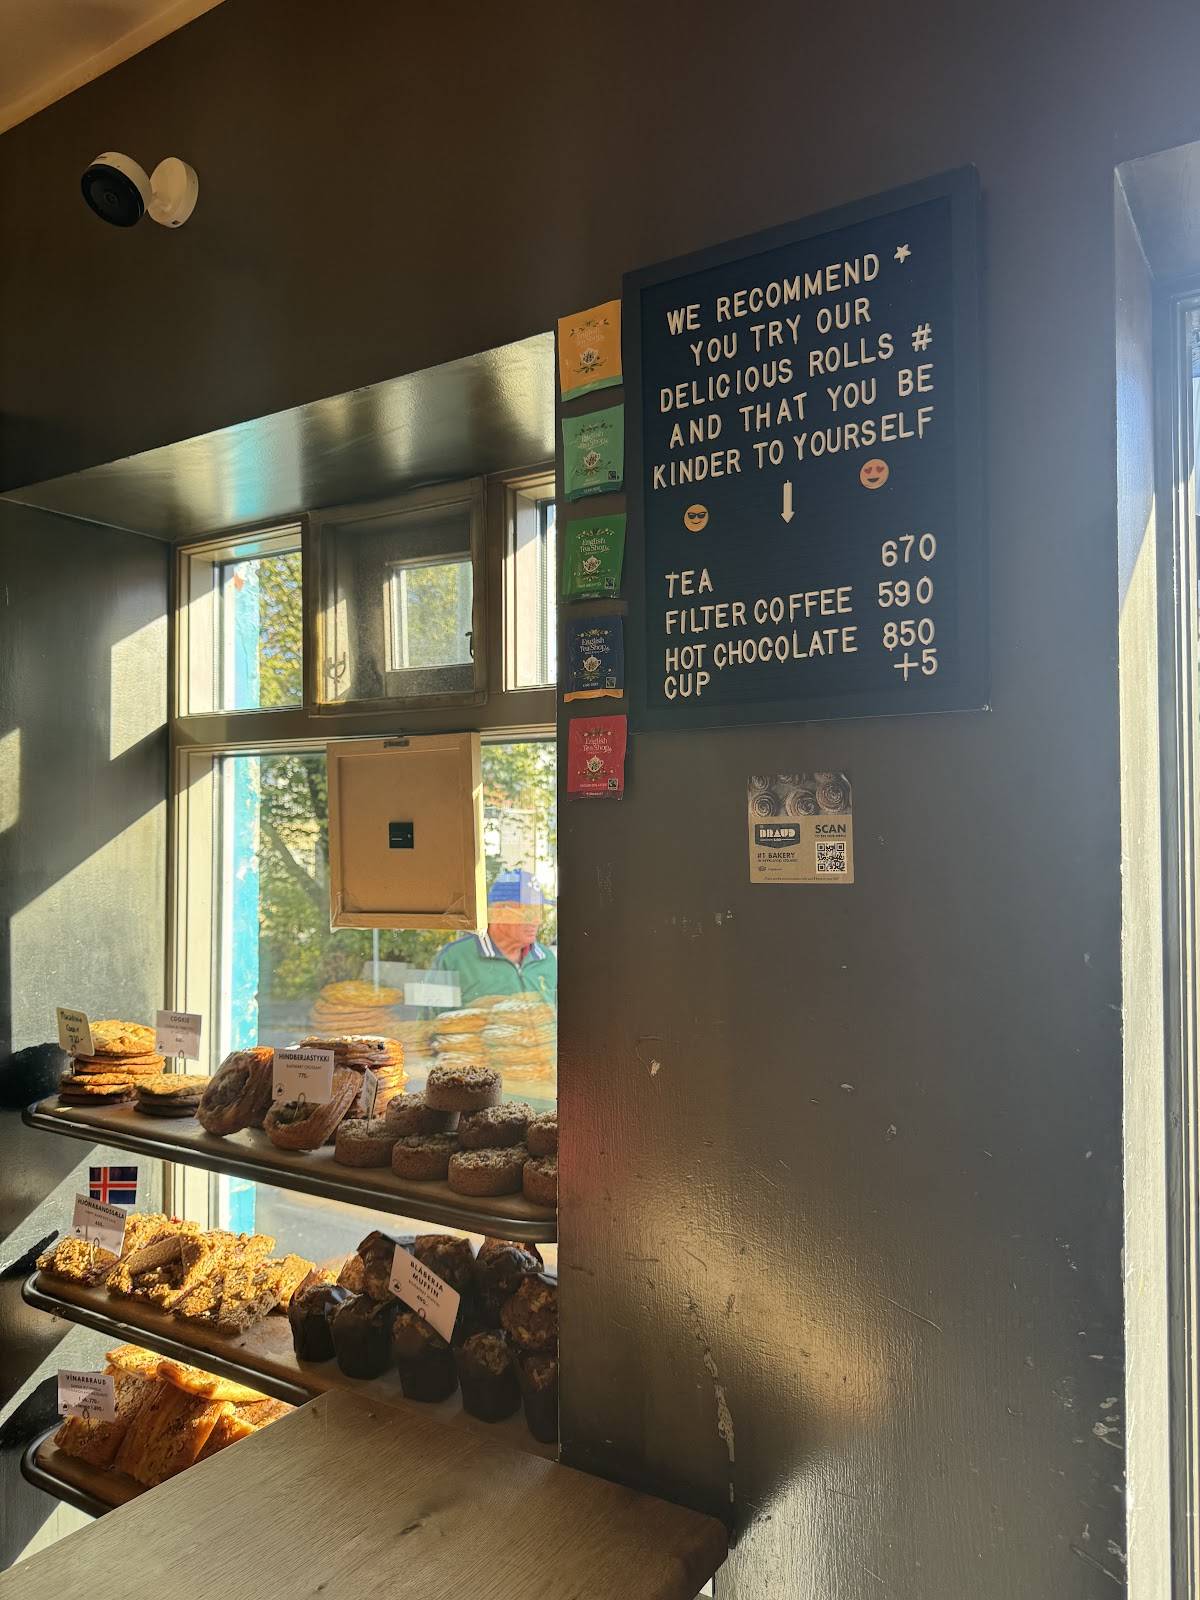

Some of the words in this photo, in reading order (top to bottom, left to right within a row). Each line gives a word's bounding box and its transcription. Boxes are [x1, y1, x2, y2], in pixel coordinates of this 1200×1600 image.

[667, 303, 701, 336] WE
[717, 253, 880, 322] RECOMMEND
[690, 332, 738, 366] YOU
[750, 314, 801, 353] TRY
[816, 297, 872, 334] OUR
[660, 359, 793, 413] DELICIOUS
[809, 333, 894, 377] ROLLS
[911, 323, 933, 352] #
[669, 414, 722, 449] AND
[739, 392, 808, 432] THAT
[826, 377, 877, 412] YOU
[898, 363, 934, 397] BE
[653, 448, 742, 490] KINDER
[753, 439, 784, 469] TO
[793, 406, 934, 461] YOURSELF
[881, 533, 937, 568] 670
[665, 568, 714, 599] TEA
[878, 576, 934, 608] 590
[665, 601, 748, 635] FILTER
[754, 586, 852, 624] COFFEE
[581, 637, 605, 647] English
[665, 643, 707, 674] HOT
[714, 626, 858, 671] CHOCOLATE
[883, 617, 935, 651] 850
[894, 648, 939, 682] +5
[664, 671, 711, 700] CUP
[584, 737, 608, 747] English
[815, 824, 846, 834] SCAN
